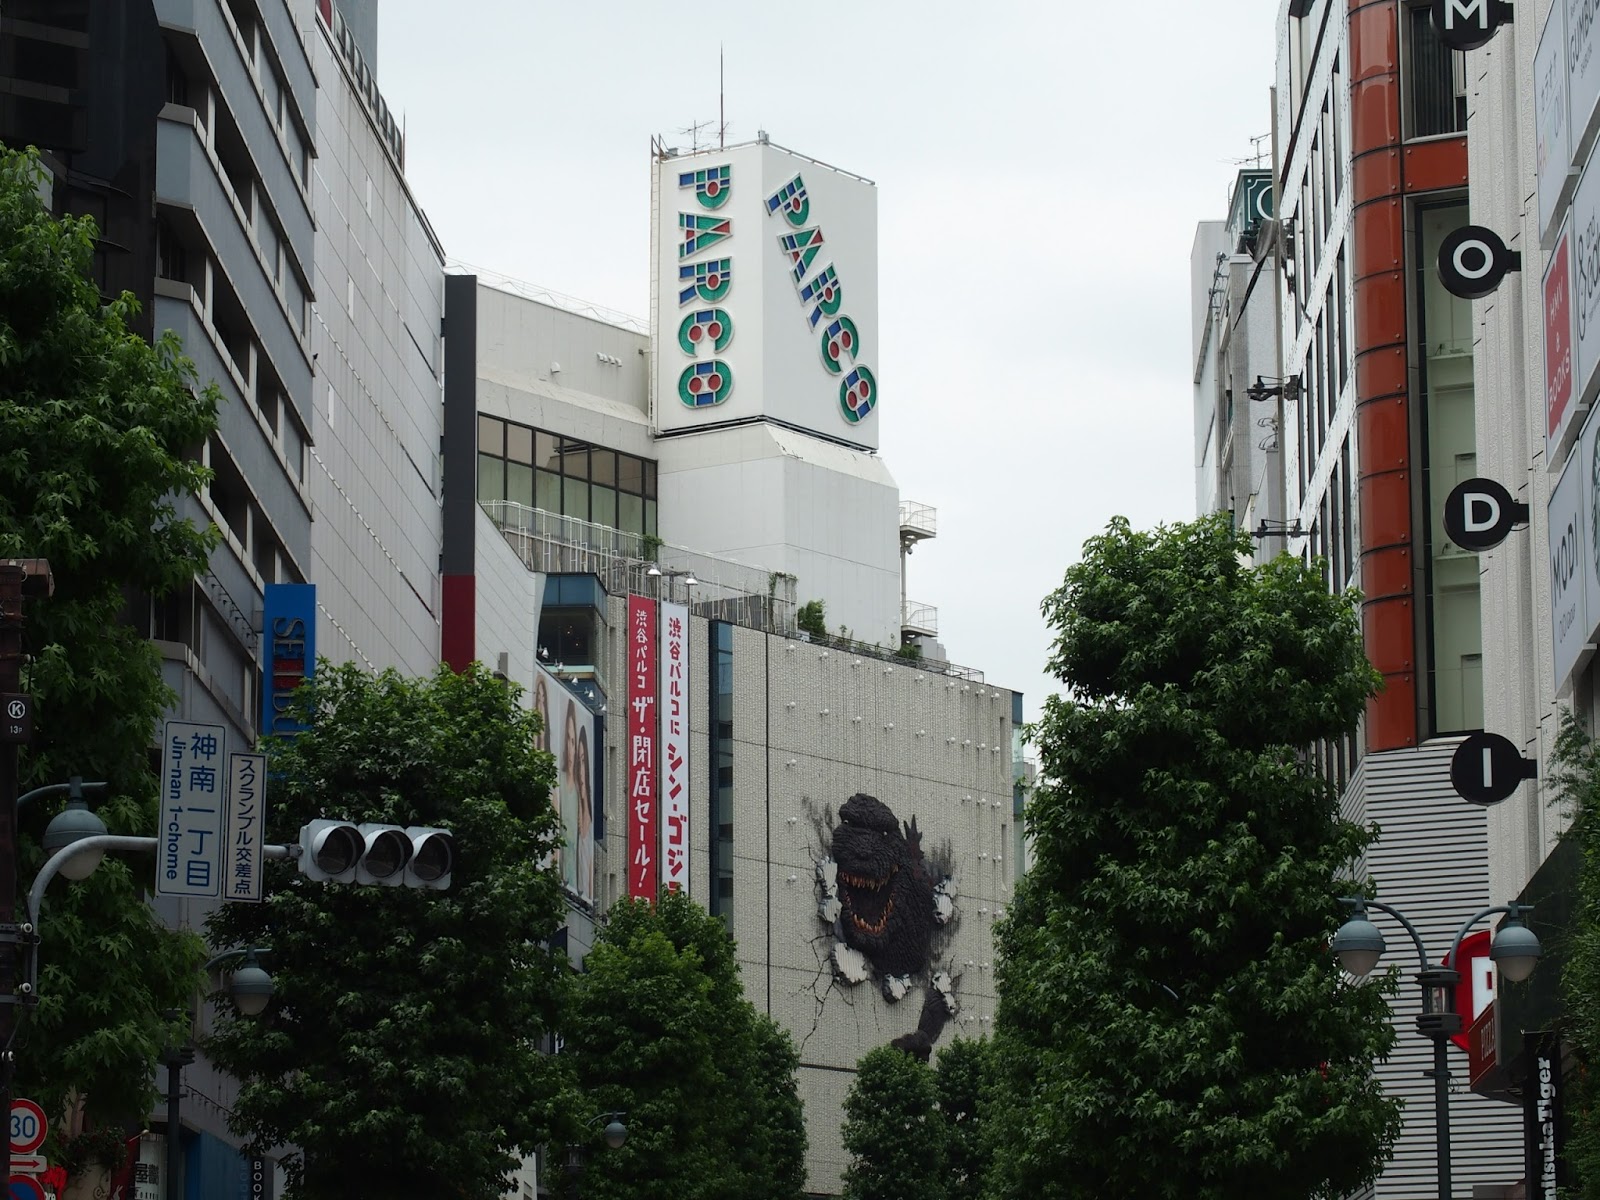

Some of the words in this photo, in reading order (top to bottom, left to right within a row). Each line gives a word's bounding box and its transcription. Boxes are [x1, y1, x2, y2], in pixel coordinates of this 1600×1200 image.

[678, 164, 735, 409] PARCO
[763, 172, 878, 427] PARCO
[1452, 239, 1494, 279] O
[1549, 348, 1570, 412] BOOKS
[1463, 492, 1500, 532] D
[1553, 511, 1578, 608] MODI
[170, 735, 187, 800] Jin-nan
[186, 733, 217, 887] 神南一丁目
[166, 806, 184, 881] 1-chome
[234, 759, 256, 895] スクランブル交差点
